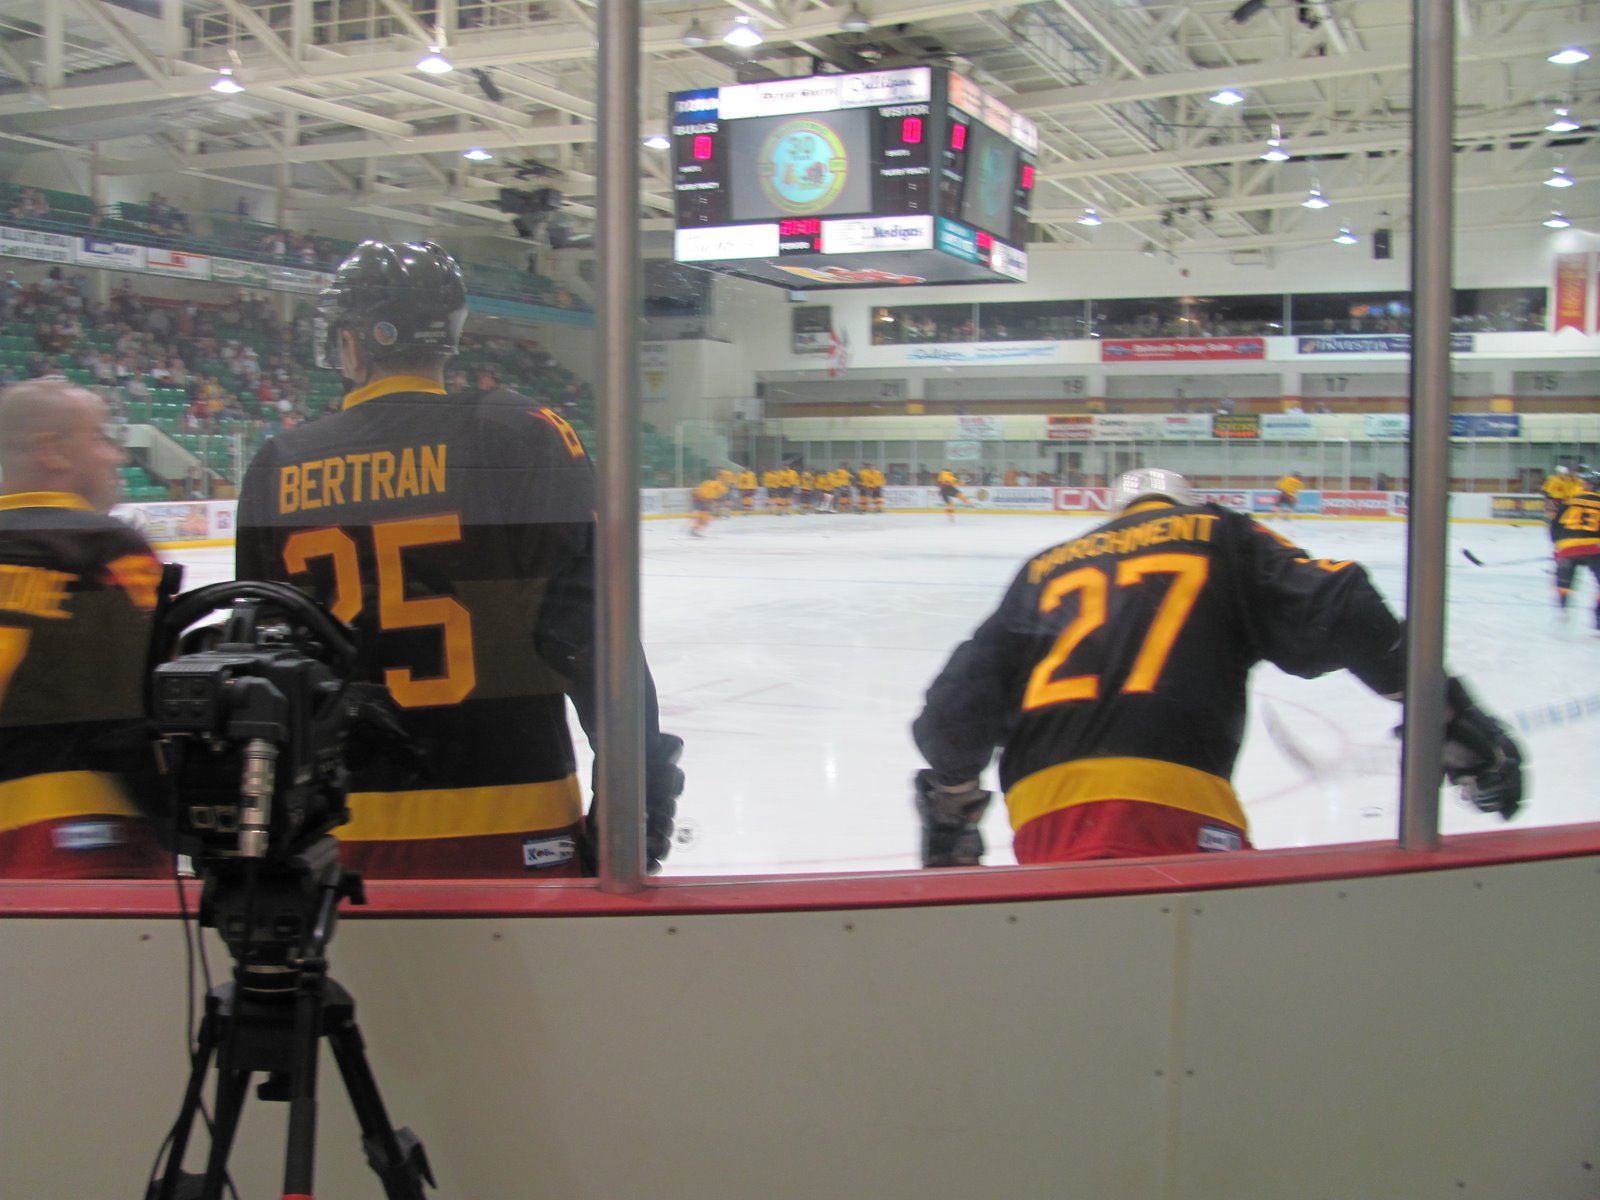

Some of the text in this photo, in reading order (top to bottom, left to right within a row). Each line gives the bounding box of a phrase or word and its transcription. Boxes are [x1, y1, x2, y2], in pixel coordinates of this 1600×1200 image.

[279, 444, 447, 514] BERTRAN
[1055, 489, 1114, 511] CN
[1021, 552, 1210, 712] 27
